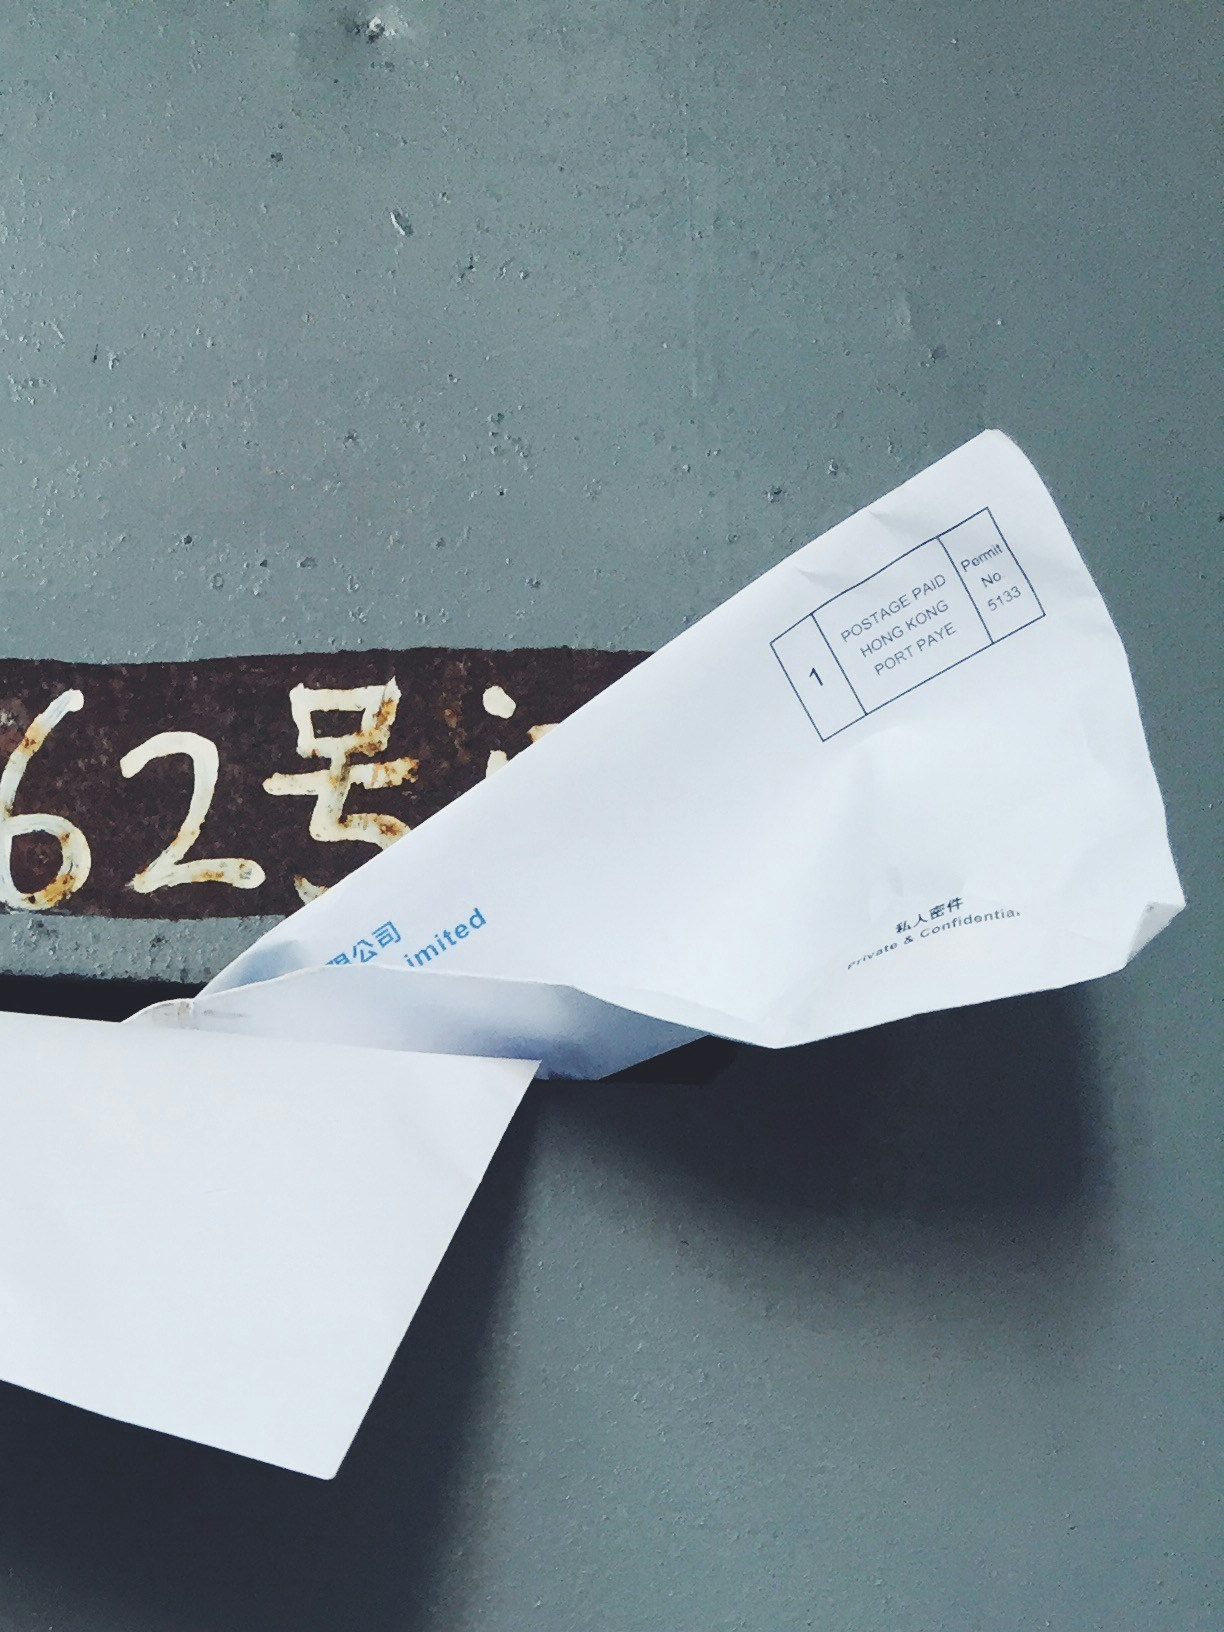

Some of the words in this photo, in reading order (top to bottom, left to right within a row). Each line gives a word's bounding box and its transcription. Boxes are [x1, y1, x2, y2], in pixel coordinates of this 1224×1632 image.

[960, 544, 1003, 572] Permit
[980, 572, 1002, 588] No
[840, 594, 911, 643] POSTAGE
[911, 574, 946, 600] PAID
[987, 586, 1021, 612] 5133
[859, 626, 904, 658] HONG
[905, 599, 949, 631] KONG
[873, 645, 913, 676] PORT
[916, 622, 957, 652] PAYE
[808, 667, 824, 687] 1
[895, 897, 964, 934] 私人密件
